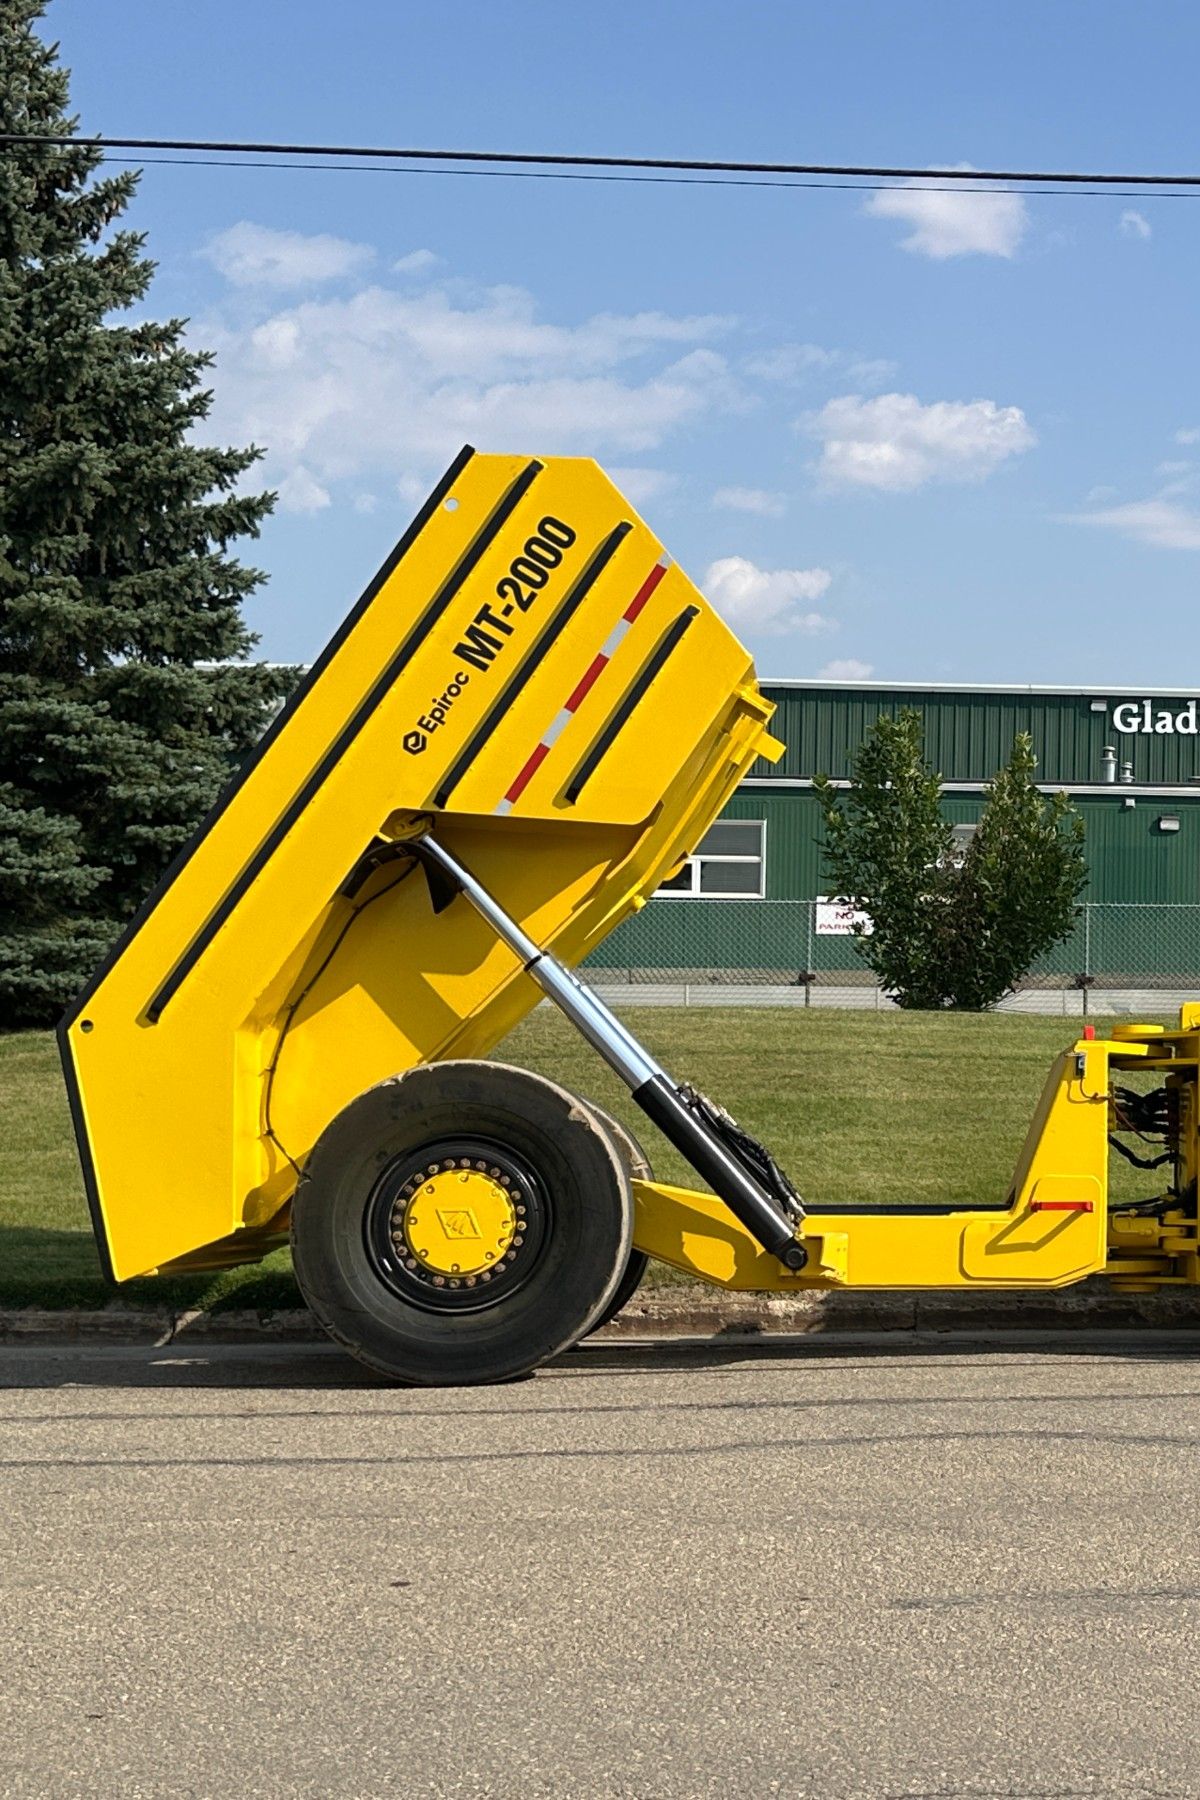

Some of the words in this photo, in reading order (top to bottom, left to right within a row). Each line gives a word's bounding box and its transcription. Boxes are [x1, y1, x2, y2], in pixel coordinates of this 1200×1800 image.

[416, 670, 470, 734] Epiroc
[452, 515, 577, 673] MT-2000
[835, 911, 854, 920] NO
